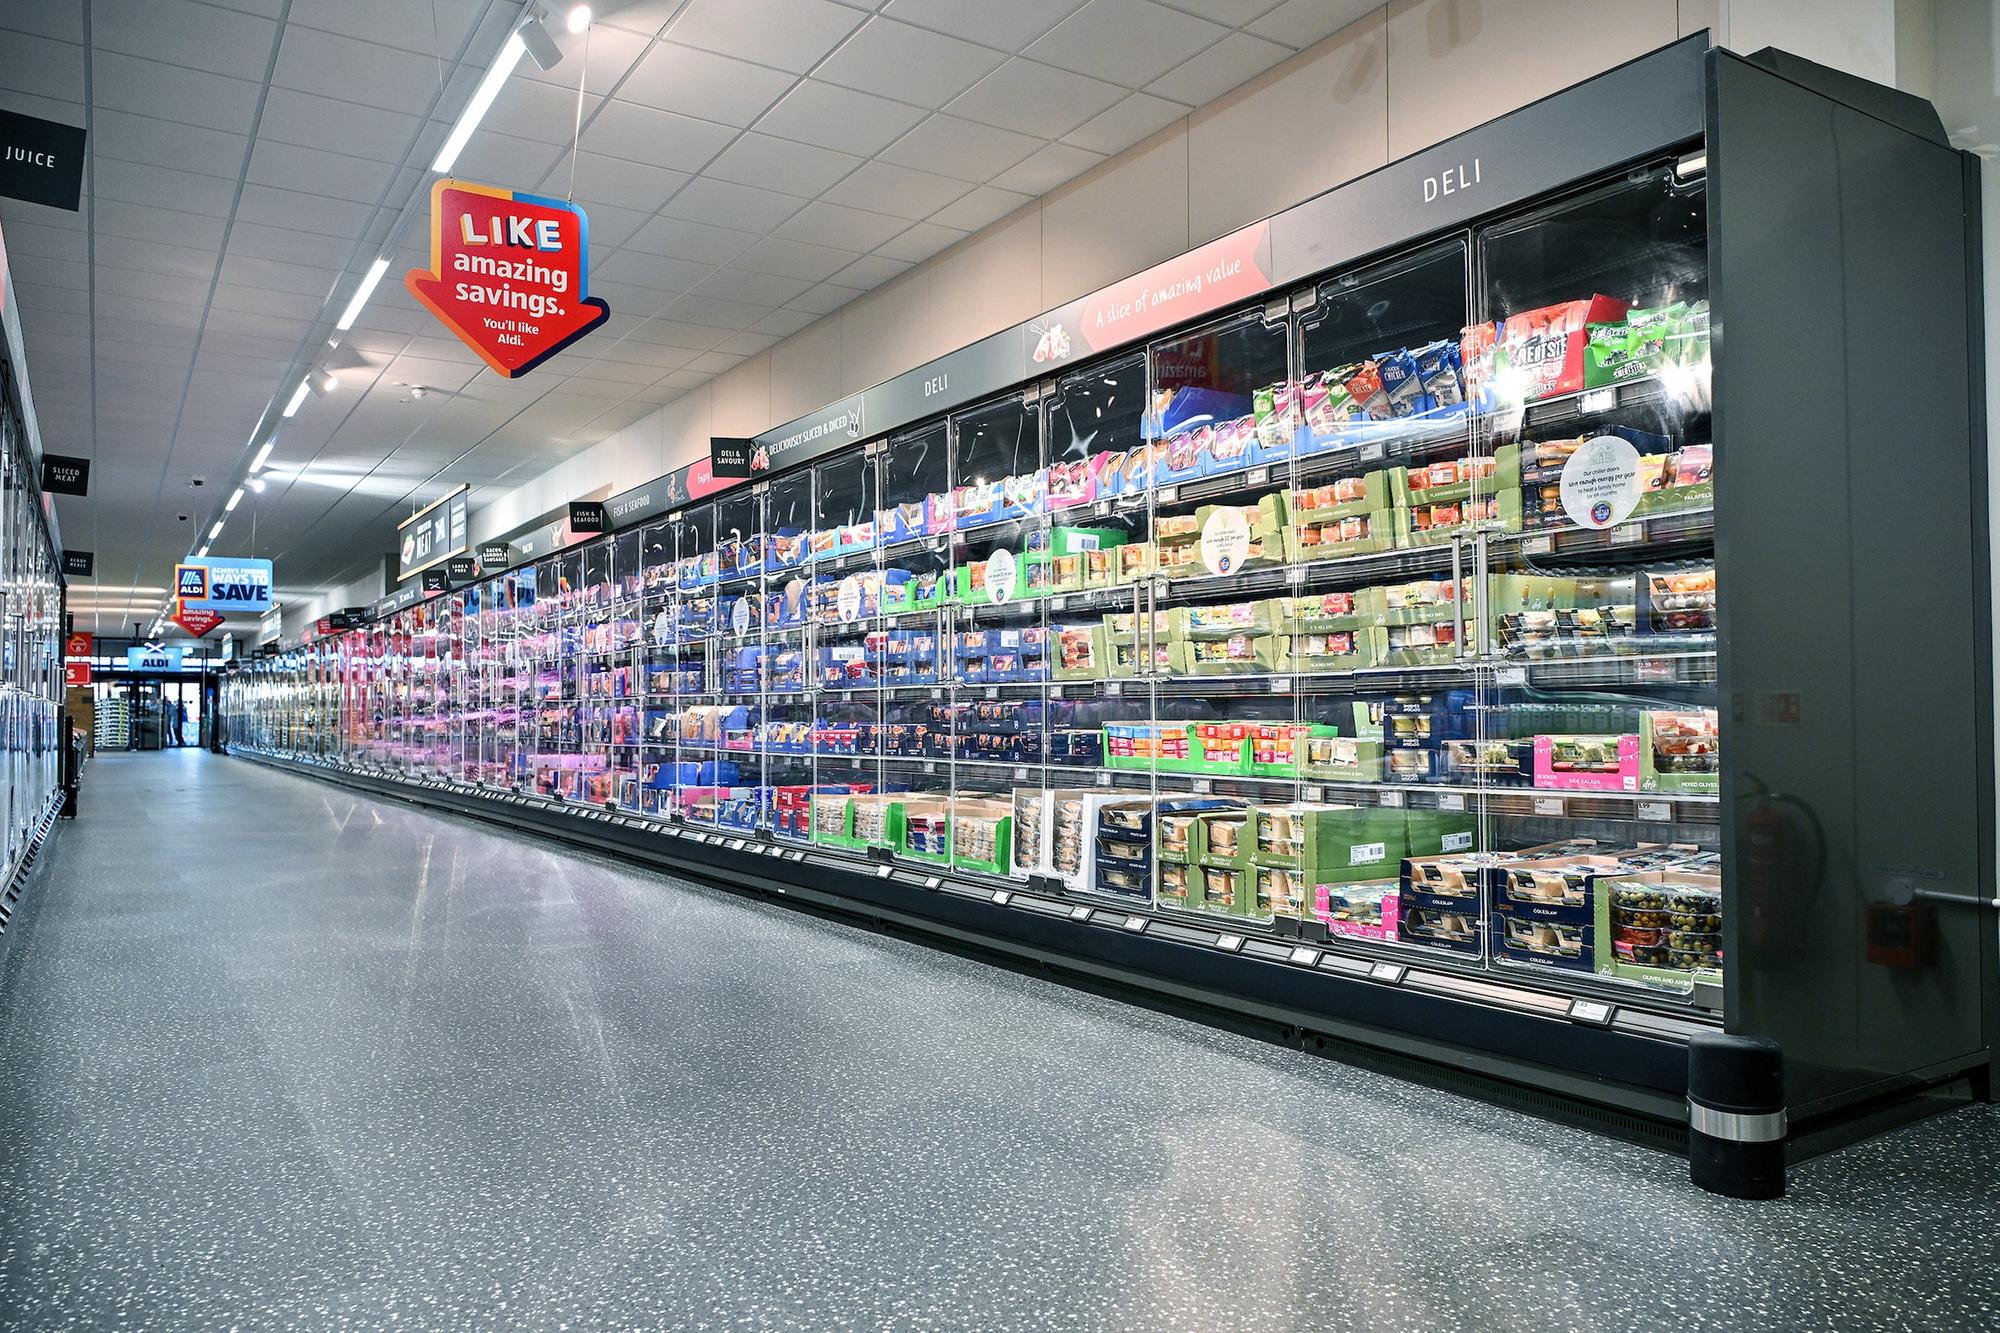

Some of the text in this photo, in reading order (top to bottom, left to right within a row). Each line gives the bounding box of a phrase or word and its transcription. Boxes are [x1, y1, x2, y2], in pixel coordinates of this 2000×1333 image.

[6, 146, 56, 169] JUICE
[1423, 157, 1481, 203] DELI
[460, 213, 562, 251] LIKE
[453, 253, 568, 293] amazing
[1096, 256, 1242, 328] A slice of amazing value
[455, 283, 566, 318] savings.
[483, 318, 539, 334] You'll like
[497, 334, 525, 346] Aldi.
[925, 373, 948, 397] DELI
[769, 415, 848, 456] DELICIOUSLY SLICED & DICED
[717, 457, 745, 465] SAVOURY
[52, 467, 80, 476] SLICED
[55, 475, 76, 483] MEAT
[613, 495, 650, 518] FISH & SEAFOOD
[416, 530, 432, 559] MEAT
[212, 573, 269, 585] WAYS TO
[180, 586, 203, 594] ALDI
[212, 584, 268, 601] SAVE
[142, 659, 169, 668] ALDI
[1533, 908, 1558, 916] COLESLAW
[1529, 957, 1554, 965] COLESLAW
[1642, 974, 1662, 982] OLIVES
